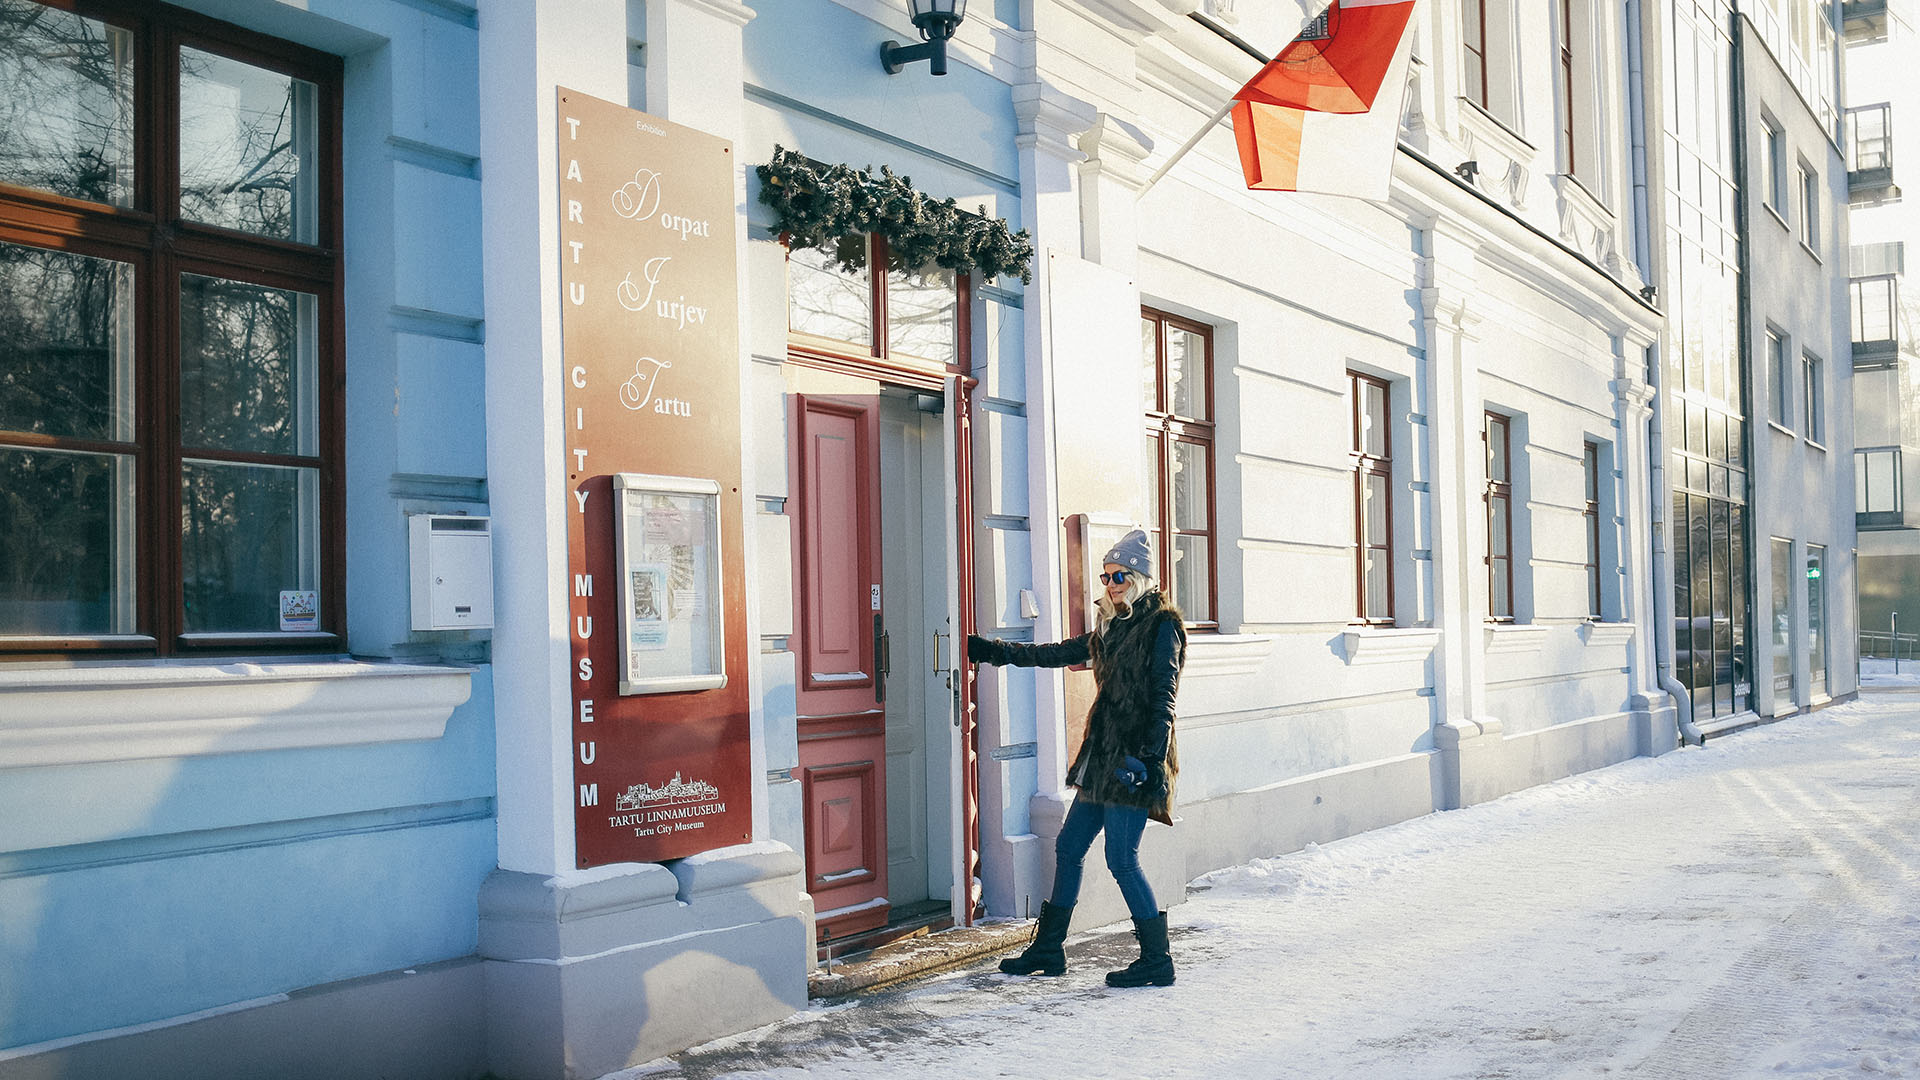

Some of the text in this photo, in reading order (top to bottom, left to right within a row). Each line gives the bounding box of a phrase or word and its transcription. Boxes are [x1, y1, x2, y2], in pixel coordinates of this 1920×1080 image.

[636, 120, 667, 137] Exhibition
[611, 168, 710, 241] Dorpat
[619, 357, 692, 417] Tartu
[566, 116, 598, 808] TARTU CITY MUSEUM
[608, 803, 726, 827] TARTU LINNAMUUSEUM
[634, 821, 705, 837] Tartu City Museum
